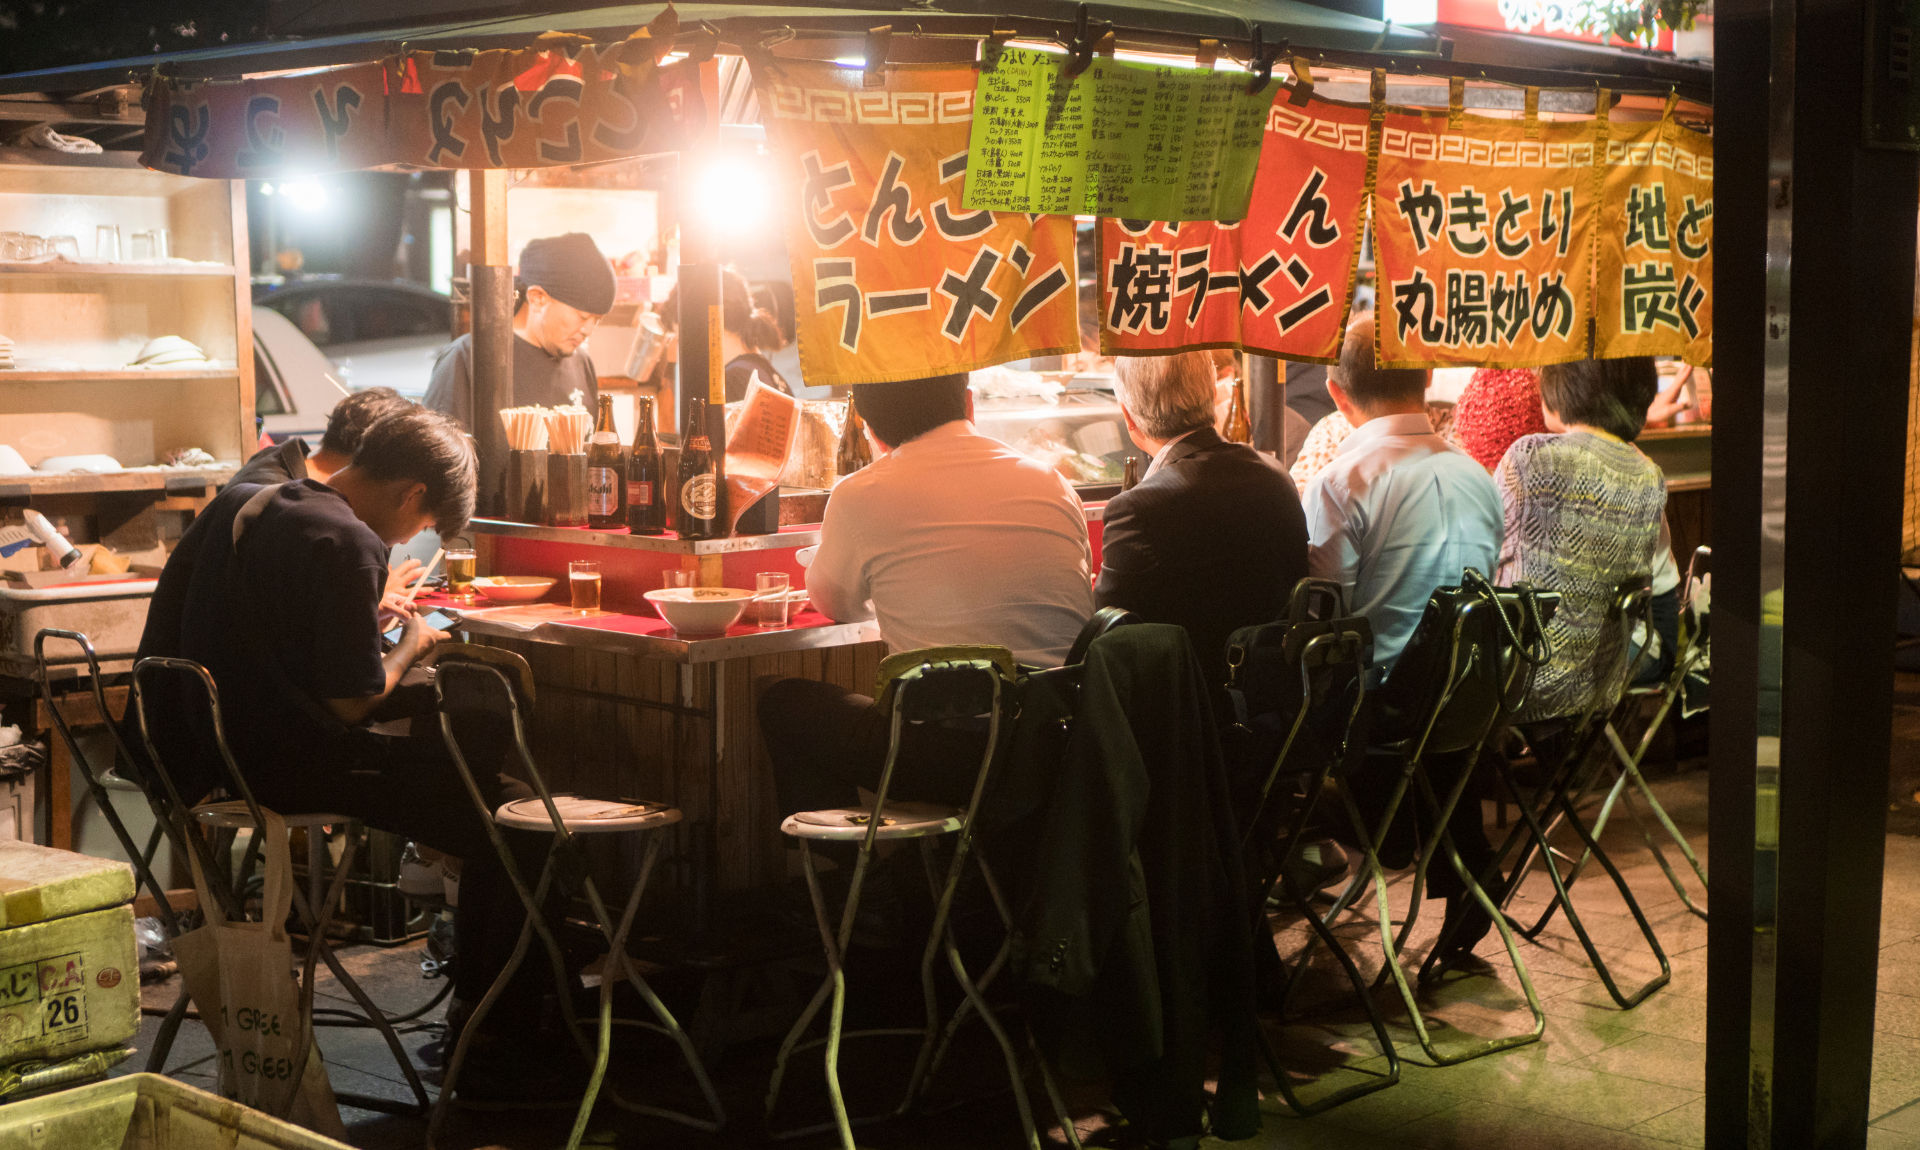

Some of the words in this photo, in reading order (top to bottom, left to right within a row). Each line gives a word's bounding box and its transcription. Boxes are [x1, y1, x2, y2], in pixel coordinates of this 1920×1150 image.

[988, 77, 1009, 86] 生ビール
[1033, 53, 1060, 65] メニュー
[801, 149, 1043, 249] とんこ
[1397, 177, 1575, 257] やきとり
[814, 241, 1072, 354] ラーメン
[1107, 242, 1333, 337] 焼ラーメン
[1392, 267, 1575, 347] 丸腸炒め
[47, 995, 79, 1029] 26
[242, 1050, 293, 1080] GEE
